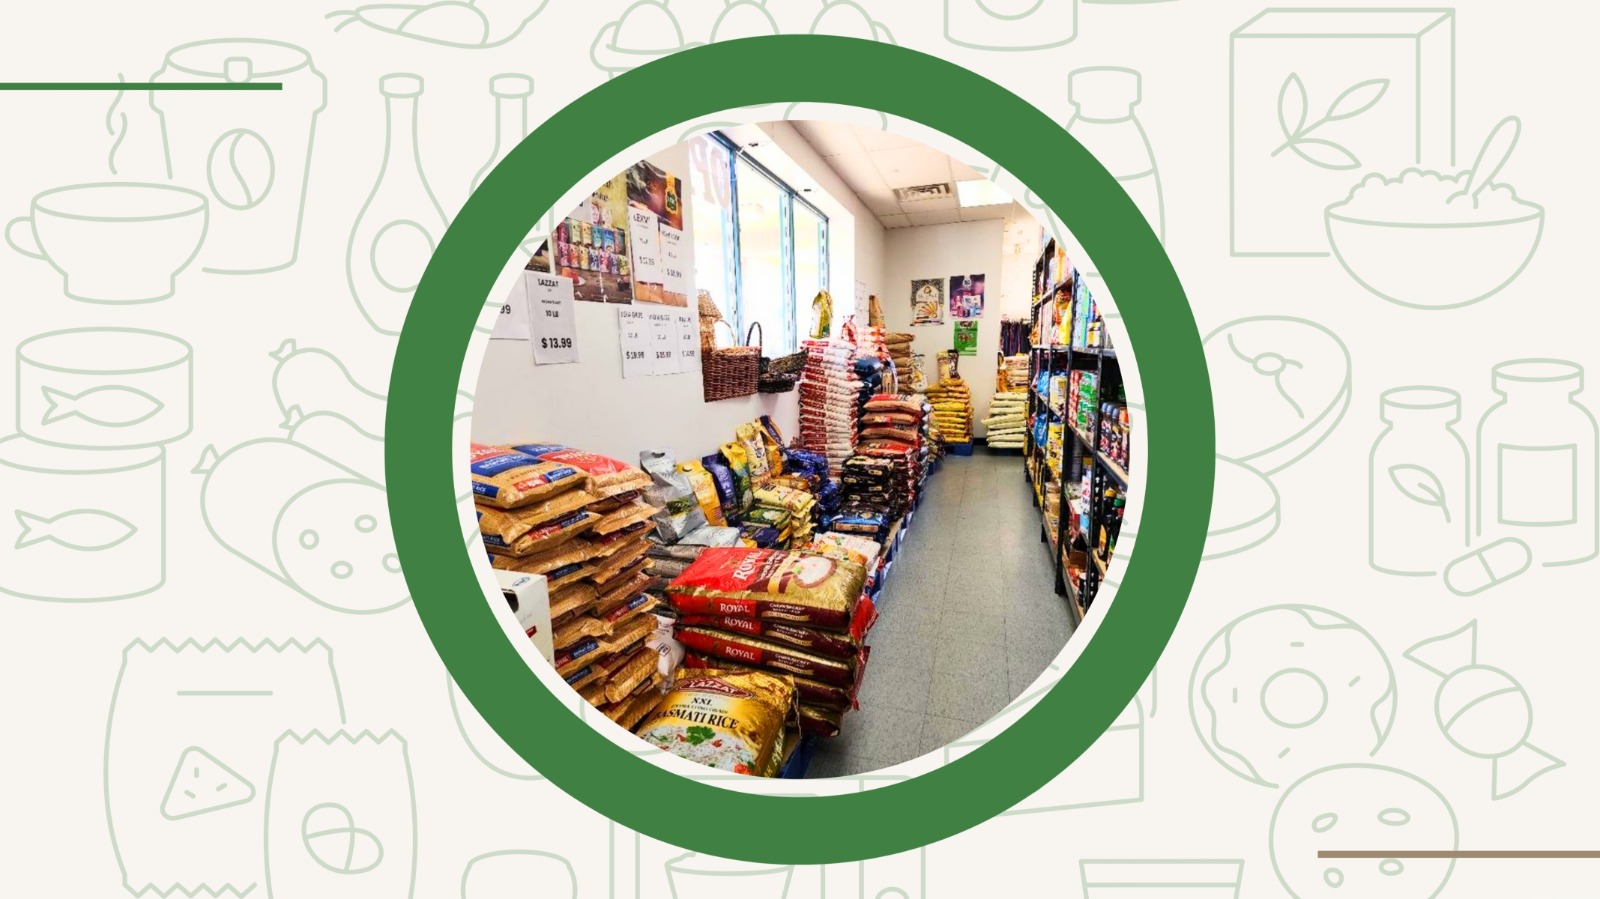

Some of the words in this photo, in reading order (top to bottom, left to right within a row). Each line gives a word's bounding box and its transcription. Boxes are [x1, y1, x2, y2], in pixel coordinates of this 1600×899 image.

[538, 278, 559, 288] LAZZAT
[720, 602, 751, 613] ROYAL
[724, 616, 755, 630] ROYAL
[725, 646, 756, 661] ROYAL
[689, 680, 738, 694] LAZZAT
[691, 697, 713, 707] XXL
[707, 713, 740, 730] RICE
